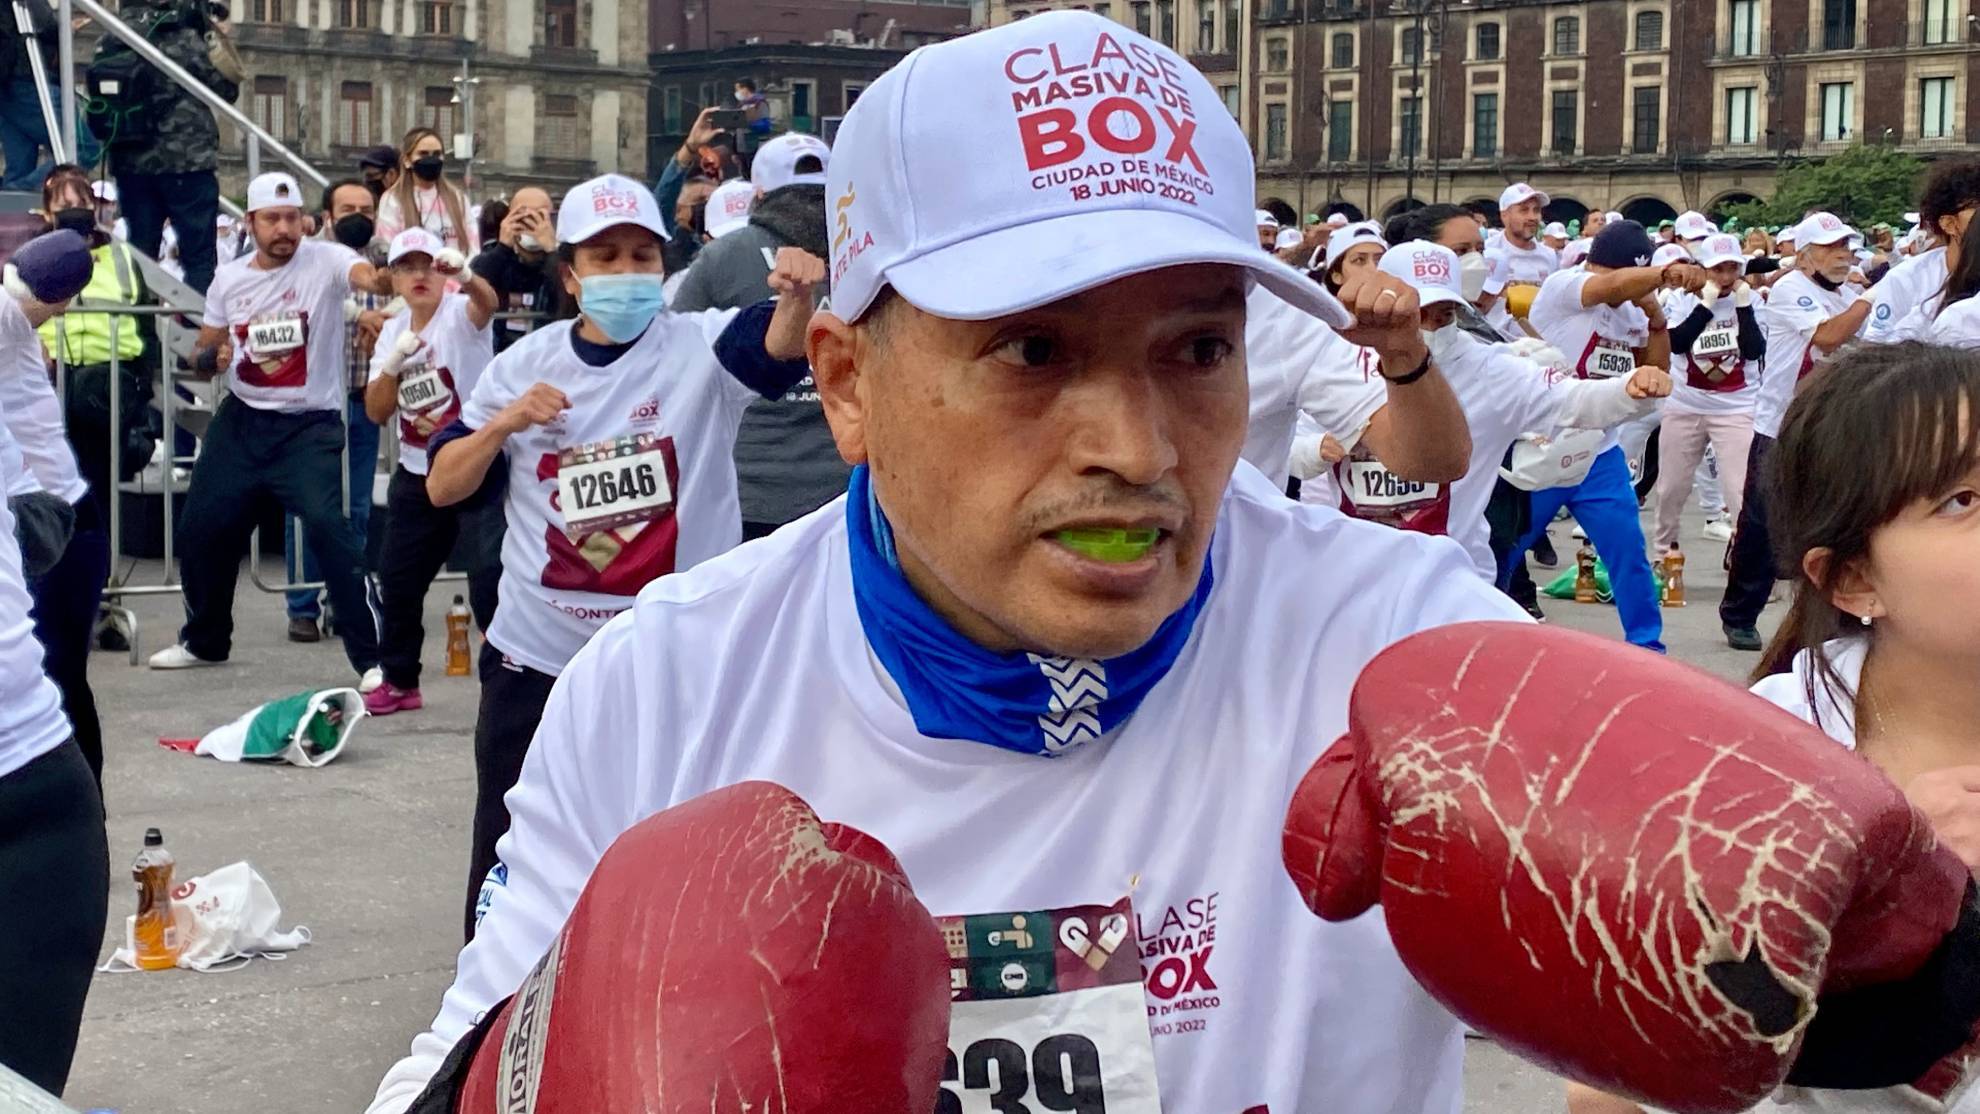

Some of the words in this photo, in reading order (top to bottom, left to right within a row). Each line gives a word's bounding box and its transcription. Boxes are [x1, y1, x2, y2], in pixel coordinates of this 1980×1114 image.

[1004, 32, 1188, 95] CLASE
[1012, 72, 1155, 112] MASIVA
[1159, 84, 1195, 118] DE
[1018, 96, 1210, 177] BOX
[1032, 162, 1115, 189] CIUDAD
[1123, 160, 1149, 174] DE
[1155, 162, 1214, 196] MÉXICO
[1070, 184, 1092, 201] 18
[1096, 179, 1155, 197] JUNIO
[1158, 183, 1198, 206] 2022
[1414, 264, 1451, 281] BOX
[1700, 332, 1731, 350] 18951
[569, 463, 657, 510] 12646
[1136, 892, 1220, 943] LASE
[1140, 947, 1218, 1000] OX
[1173, 995, 1221, 1012] MÉXICO
[1176, 1019, 1207, 1033] 2022
